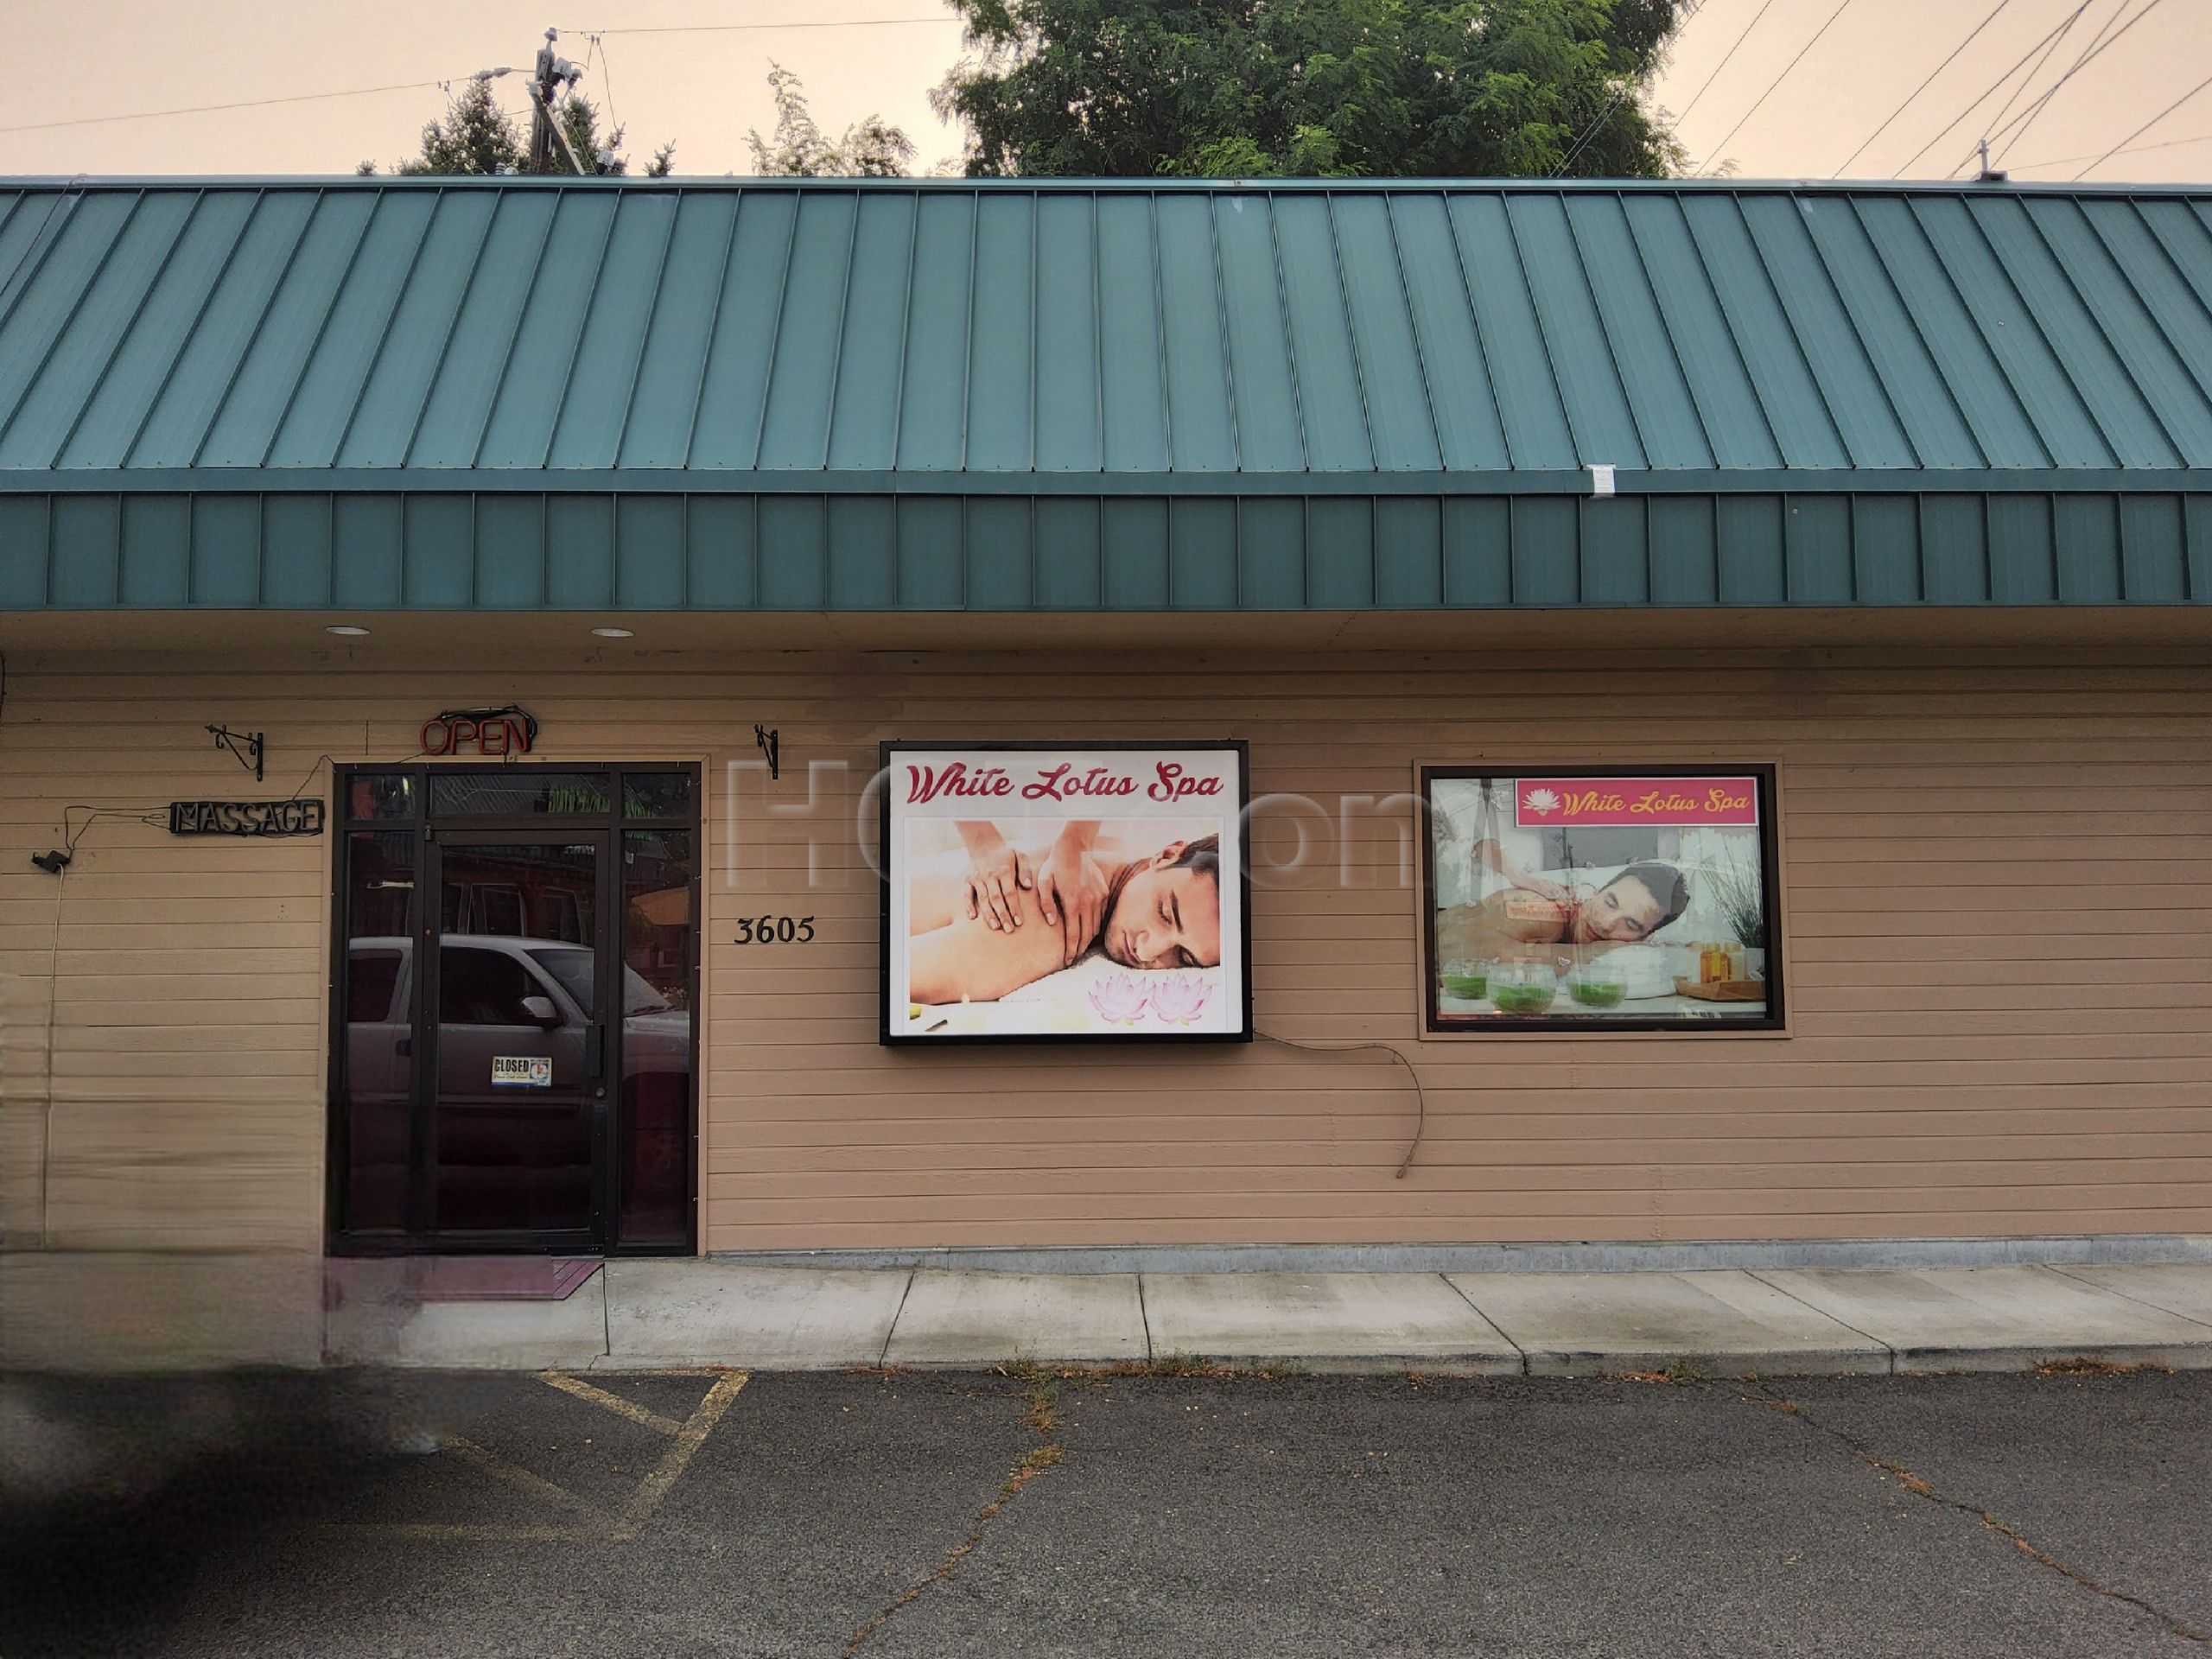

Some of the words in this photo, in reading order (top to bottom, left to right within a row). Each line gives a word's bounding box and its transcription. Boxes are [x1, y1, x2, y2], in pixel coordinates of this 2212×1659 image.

[421, 718, 531, 755] OPEN
[906, 761, 1014, 804] White
[1021, 760, 1138, 803] Lotus
[1147, 760, 1224, 803] Spa
[1562, 790, 1626, 817] White
[1630, 790, 1700, 815] Lotus
[1703, 787, 1750, 813] Spa
[175, 802, 321, 833] MASSAGE
[734, 914, 815, 944] 3605
[494, 1058, 529, 1072] CLOSED
